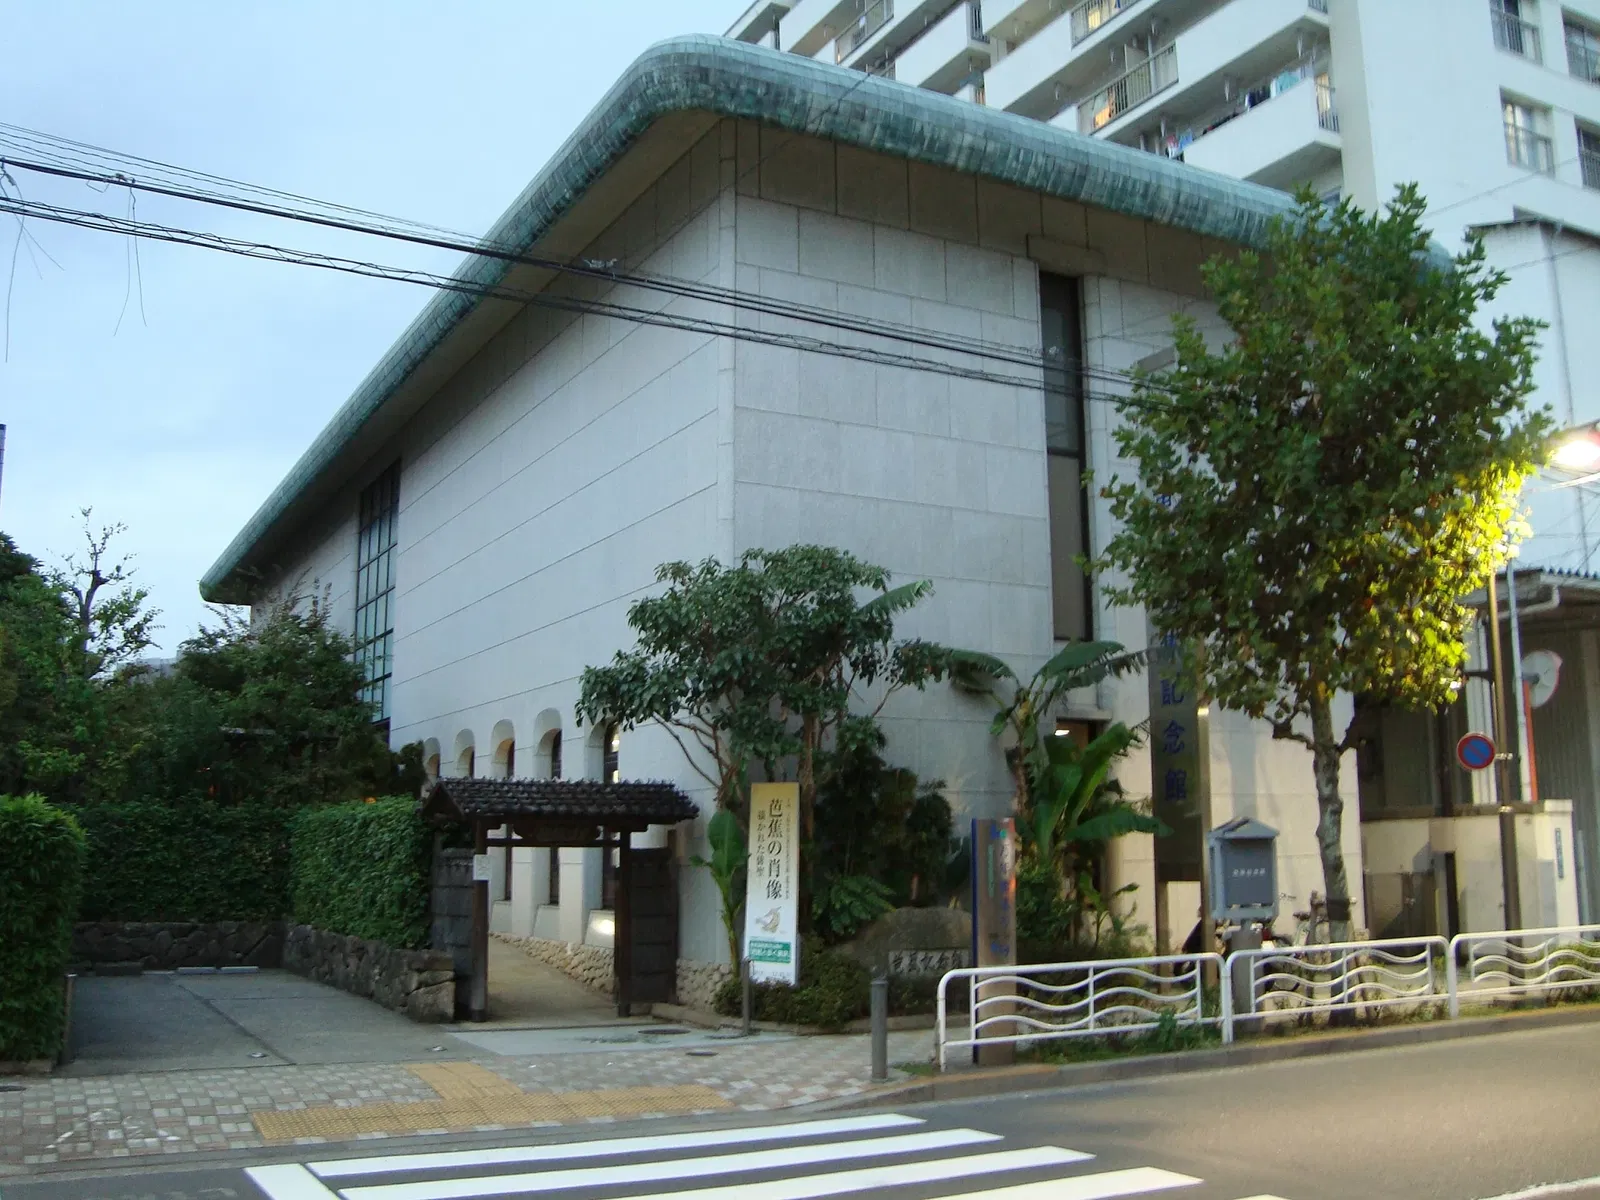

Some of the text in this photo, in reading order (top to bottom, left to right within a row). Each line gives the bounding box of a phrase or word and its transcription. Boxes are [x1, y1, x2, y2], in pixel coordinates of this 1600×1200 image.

[766, 798, 783, 900] 芭蕉の肖像
